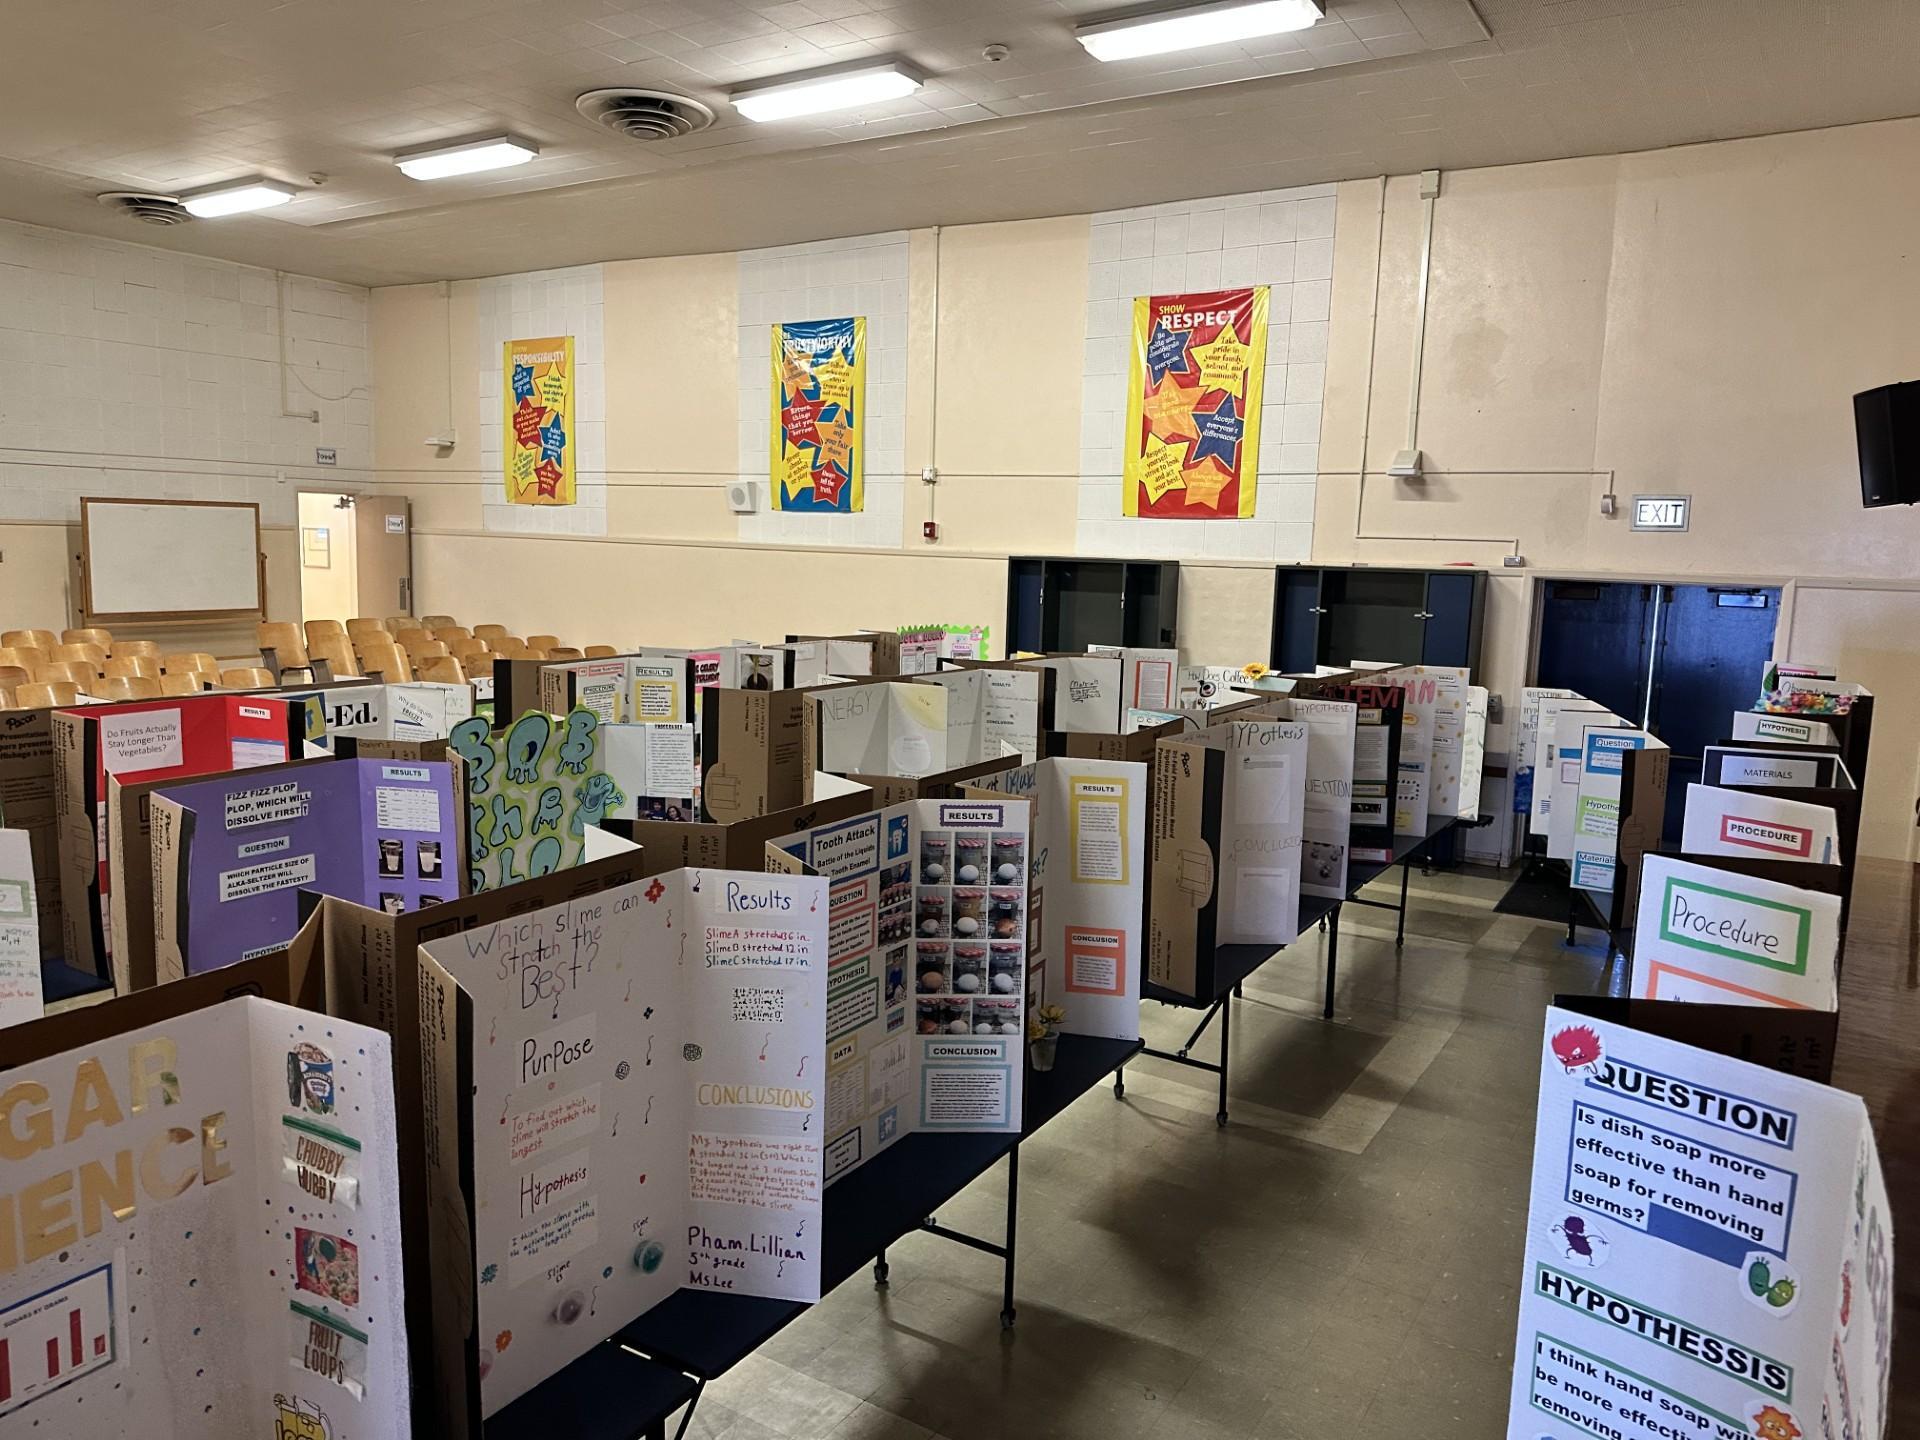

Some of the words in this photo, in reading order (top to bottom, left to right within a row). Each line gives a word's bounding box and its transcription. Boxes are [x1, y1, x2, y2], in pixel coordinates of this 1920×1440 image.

[1159, 304, 1185, 315] SHOW
[1162, 310, 1237, 330] RESPECT
[1221, 336, 1236, 346] Take
[1213, 346, 1230, 356] pride
[1204, 354, 1220, 366] your
[1232, 364, 1244, 372] and
[788, 422, 801, 431] that
[803, 420, 815, 429] you
[792, 412, 811, 422] things
[834, 420, 847, 430] Take
[1212, 415, 1235, 427] Accept
[833, 430, 844, 439] only
[1206, 422, 1238, 434] everyone's
[825, 438, 837, 446] your
[1146, 445, 1167, 461] Respect
[1155, 473, 1164, 483] and
[1153, 482, 1164, 495] your
[1638, 504, 1683, 523] EXIT
[638, 668, 671, 676] RESULTS
[1203, 668, 1221, 681] Does
[1222, 669, 1249, 685] Coffee
[326, 702, 378, 728] -Ed.
[107, 730, 118, 739] Do
[120, 727, 144, 738] Fruits
[145, 723, 177, 736] Actually
[1761, 722, 1808, 736] HYPOTHESIS
[108, 740, 125, 751] Stay
[127, 737, 155, 749] Longer
[157, 733, 177, 743] Than
[1596, 738, 1634, 748] Question
[119, 745, 167, 759] Vegetables?
[390, 769, 422, 777] RESULTS
[1181, 752, 1191, 777] Pacon
[1743, 768, 1793, 780] MATERIALS
[227, 791, 248, 803] FIZZ
[250, 787, 271, 799] FIZZ
[273, 783, 296, 795] PLOP
[1082, 785, 1115, 793] RESULTS
[256, 798, 288, 811] WHICH
[290, 792, 311, 806] WILL
[227, 811, 274, 828] DISSOLVE
[948, 812, 994, 820] RESULTS
[816, 836, 843, 852] Tooth
[846, 826, 875, 841] Attack
[1730, 823, 1798, 843] PROCEDURE
[244, 839, 285, 853] QUESTION
[817, 855, 836, 869] Battle
[836, 853, 843, 862] of
[844, 850, 854, 860] the
[855, 845, 875, 857] Liquids
[227, 870, 249, 881] WHICH
[251, 865, 282, 877] PARTICLE
[284, 860, 299, 869] SIZE
[300, 857, 309, 866] OF
[831, 865, 849, 876] Tooth
[849, 857, 870, 871] Enamel
[227, 874, 277, 889] ALKA-SELTZER
[279, 868, 293, 879] WILL
[228, 886, 260, 898] DISSOLVE
[261, 883, 275, 892] THE
[276, 874, 308, 888] FASTEST?
[726, 880, 792, 913] Results
[830, 889, 863, 907] QUESTION
[464, 911, 544, 960] Which
[556, 902, 603, 935] slime
[613, 895, 639, 914] can
[1672, 895, 1779, 954] Procedure
[1072, 934, 1118, 944] CONCLUSION
[244, 943, 288, 960] HYPOTHES
[498, 938, 562, 981] stretch
[574, 918, 602, 954] the
[743, 944, 783, 953] stretched
[786, 944, 795, 954] 12
[797, 945, 809, 954] in
[785, 957, 794, 966] 17
[829, 966, 865, 987] YPOTHESIS
[834, 1046, 852, 1060] DATA
[932, 1047, 997, 1057] CONCLUSION
[698, 1082, 815, 1109] CONCLUSIONS
[1593, 1063, 1788, 1142] QUESTION
[1576, 1108, 1595, 1126] Is
[1601, 1114, 1643, 1142] dish
[1650, 1132, 1701, 1160] soap
[1707, 1152, 1766, 1180] more
[296, 1135, 344, 1178] CHUBBY
[1574, 1135, 1665, 1176] effective
[1671, 1166, 1720, 1195] than
[1727, 1184, 1783, 1217] hand
[520, 1168, 586, 1219] Hypothesis
[1573, 1161, 1621, 1189] soap
[1626, 1177, 1656, 1200] for
[1661, 1190, 1764, 1243] removing
[1570, 1187, 1645, 1223] germs?
[713, 1257, 746, 1269] grade
[713, 1275, 734, 1289] Lee
[309, 1321, 342, 1353] FRUIT
[1540, 1270, 1787, 1390] HYPOTHESSIS
[303, 1344, 344, 1385] LOOPS
[1534, 1365, 1558, 1383] be
[1563, 1378, 1613, 1411] more
[1536, 1340, 1543, 1354] I
[1548, 1346, 1598, 1378] think
[1603, 1369, 1653, 1403] hand
[1658, 1395, 1710, 1430] soap
[1532, 1392, 1625, 1440] removing
